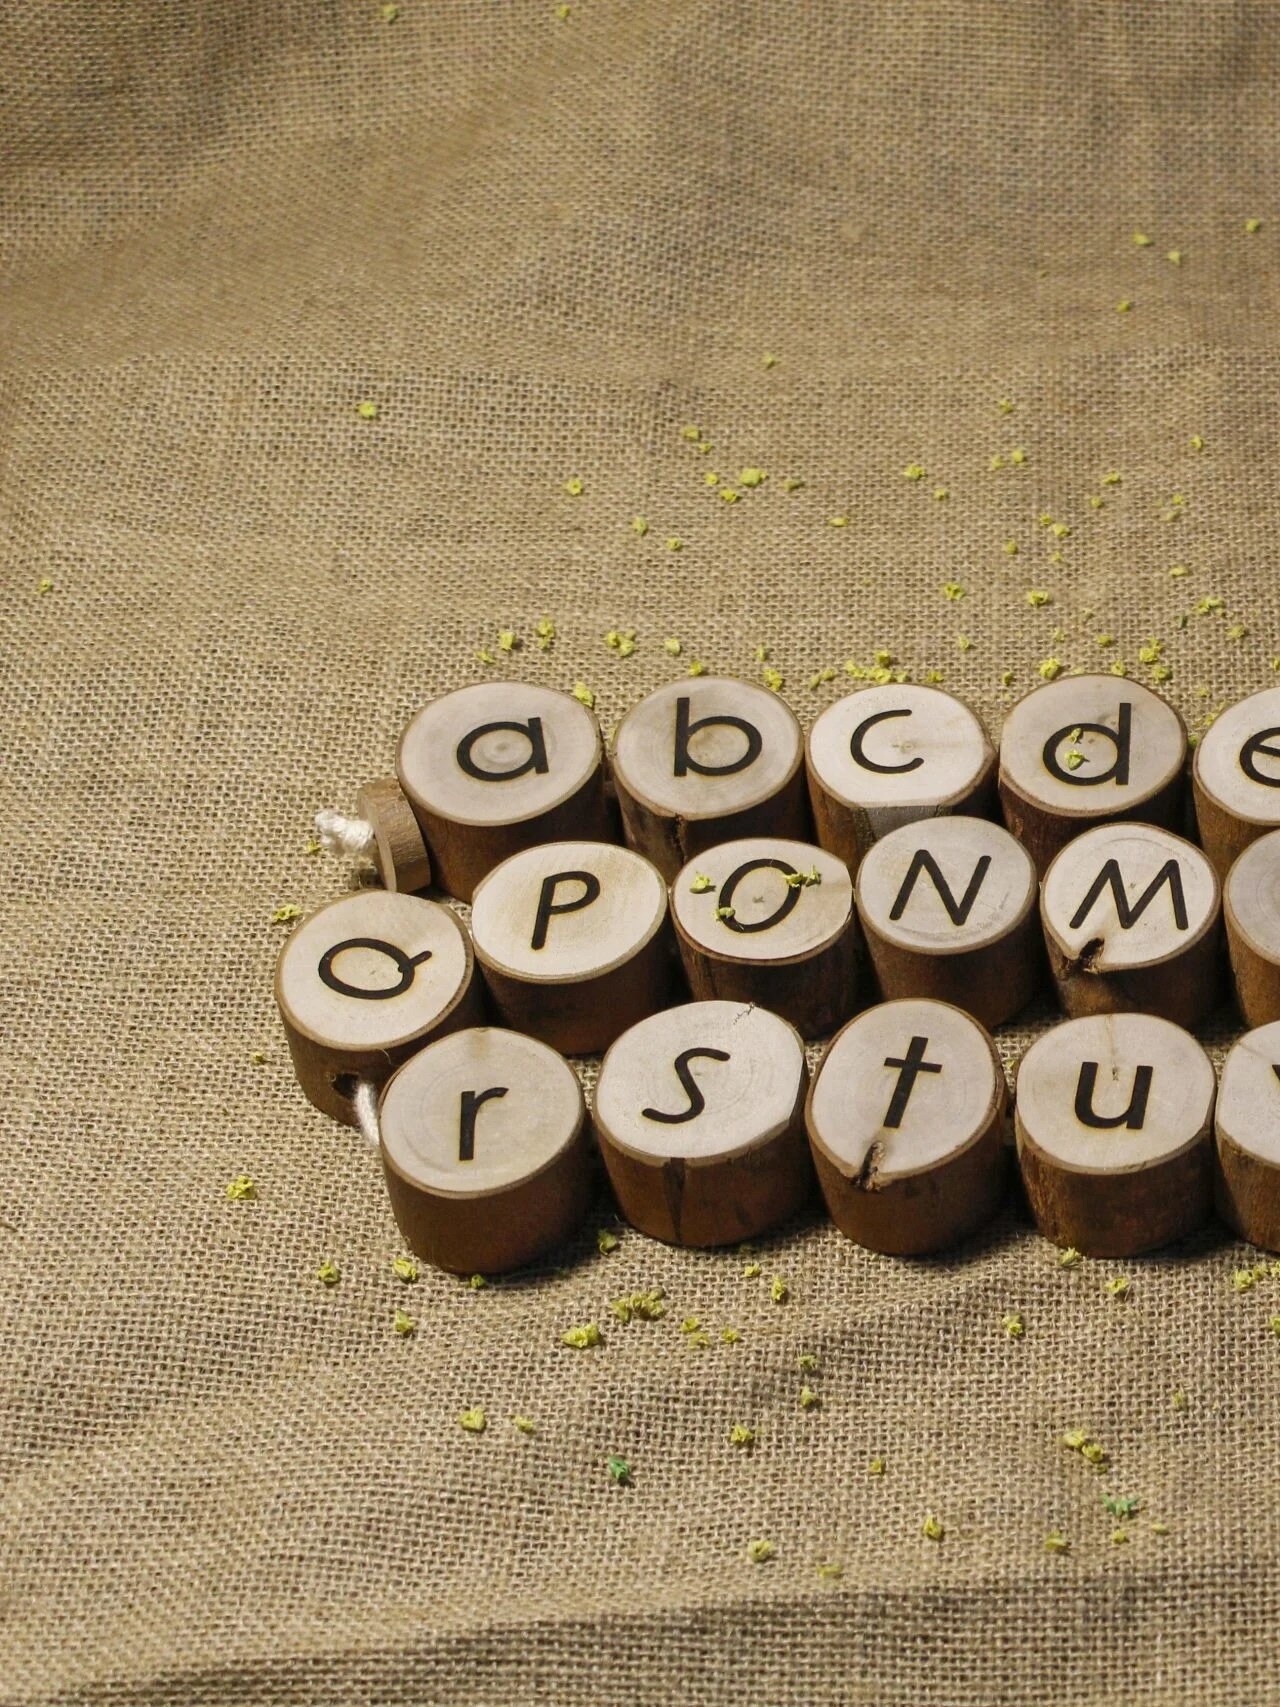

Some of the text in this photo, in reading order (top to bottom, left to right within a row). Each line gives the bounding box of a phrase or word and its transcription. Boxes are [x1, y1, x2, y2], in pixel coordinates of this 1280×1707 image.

[457, 717, 548, 782] a
[674, 697, 762, 777] b
[1043, 703, 1131, 786] d
[318, 938, 432, 1000] Q
[532, 871, 600, 950] P
[890, 850, 991, 926] N
[1070, 859, 1188, 930] M
[459, 1088, 508, 1161] r
[883, 1037, 942, 1128] t
[1075, 1062, 1153, 1129] u
